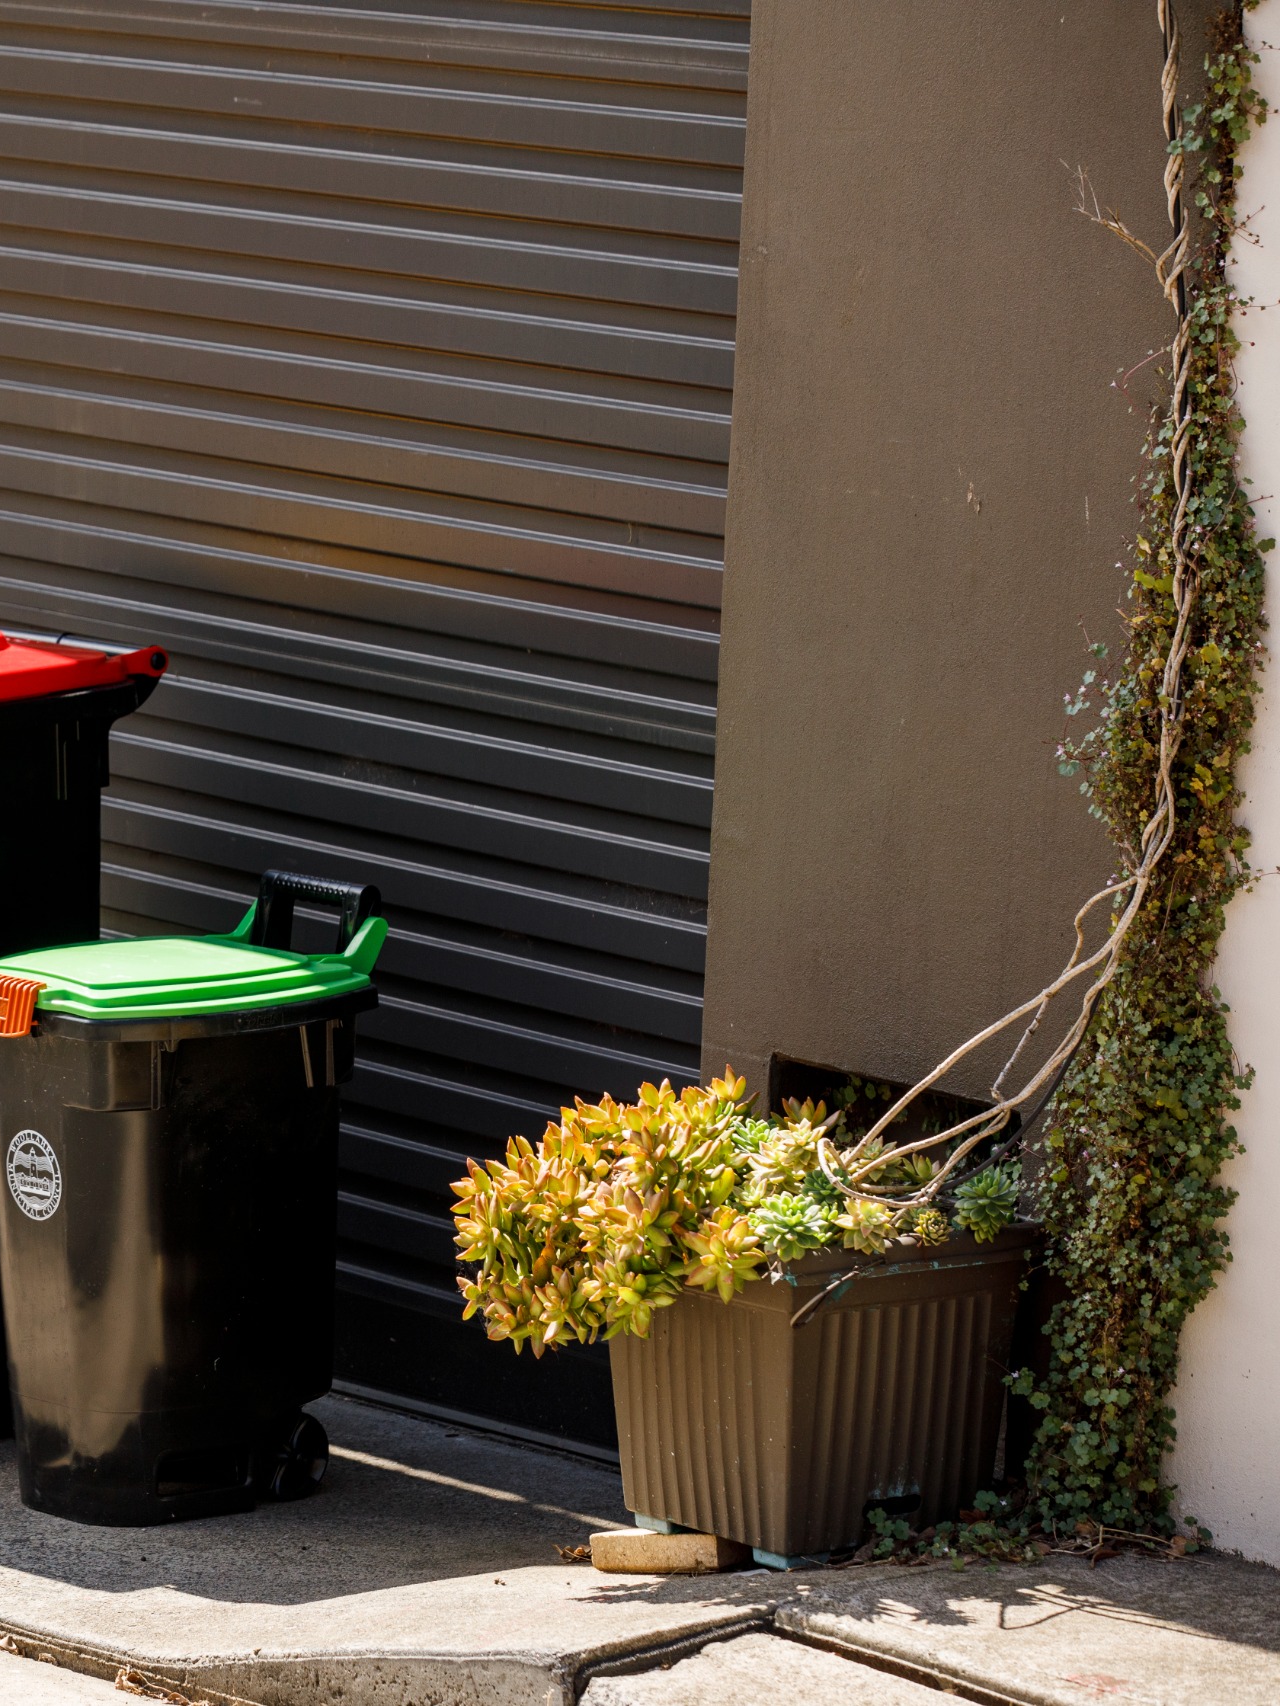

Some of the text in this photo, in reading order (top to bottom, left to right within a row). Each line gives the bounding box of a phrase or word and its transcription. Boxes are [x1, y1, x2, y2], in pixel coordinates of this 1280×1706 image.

[11, 1132, 55, 1163] WOOLLAHRA
[8, 1163, 60, 1217] MUNICIPAL COUNCIL
